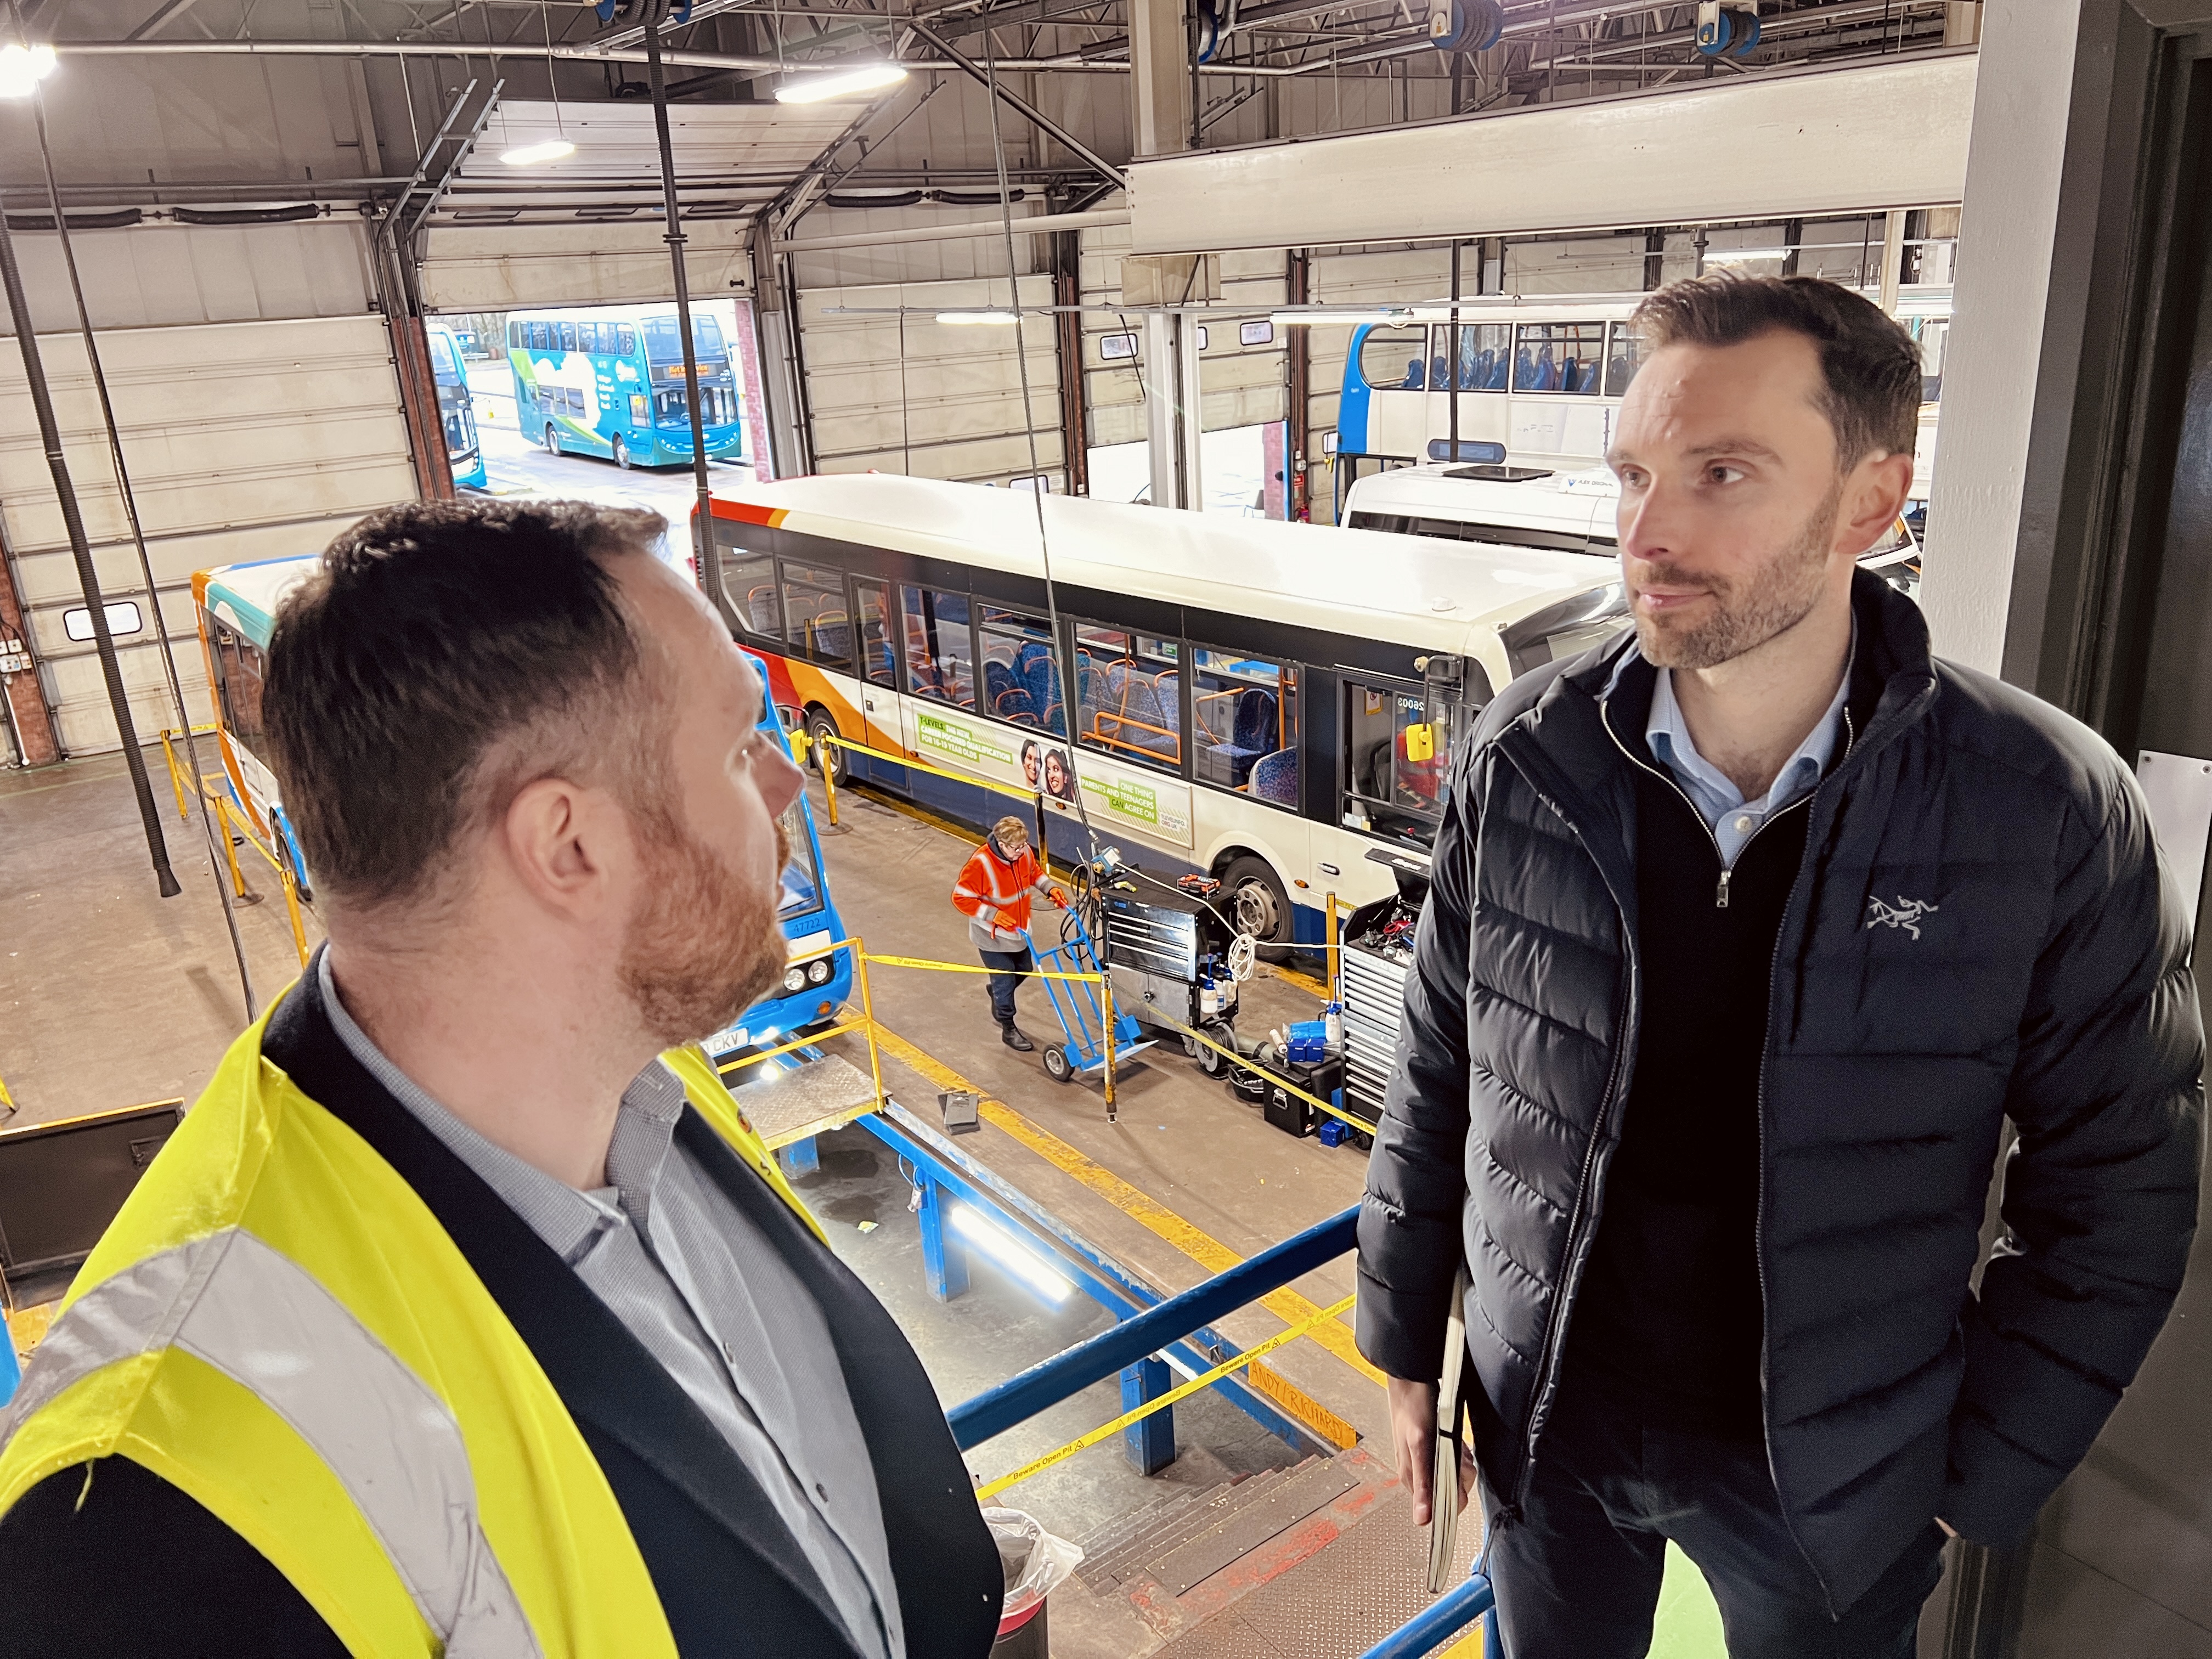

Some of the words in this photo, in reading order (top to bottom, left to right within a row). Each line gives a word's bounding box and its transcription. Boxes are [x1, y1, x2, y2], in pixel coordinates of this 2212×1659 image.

[920, 716, 945, 730] T-LEVELS.
[946, 725, 956, 735] THE
[921, 725, 941, 739] CAREER
[942, 732, 966, 747] FOCUSED
[966, 741, 1011, 762] QUALIFICATION
[922, 734, 933, 744] FOR
[933, 738, 947, 749] 16-19
[948, 742, 962, 754] YEAR
[962, 748, 977, 759] OLDS
[1081, 778, 1106, 793] PARENTS
[1106, 788, 1120, 798] AND
[1120, 792, 1154, 810] TEENAGERS
[1120, 782, 1133, 793] ONE
[1134, 786, 1153, 800] THING
[1111, 799, 1124, 809] CAN
[1124, 803, 1143, 816] AGREE
[1144, 809, 1154, 820] ON
[713, 1032, 738, 1052] CKV
[1221, 1357, 1244, 1373] Beware
[1245, 1348, 1261, 1361] Open
[1262, 1342, 1271, 1352] Pit
[1251, 1362, 1280, 1397] ANDY
[1289, 1390, 1343, 1440] RICHARD
[1013, 1462, 1041, 1480] Beware
[1042, 1451, 1061, 1465] Open
[1063, 1445, 1073, 1455] Pit
